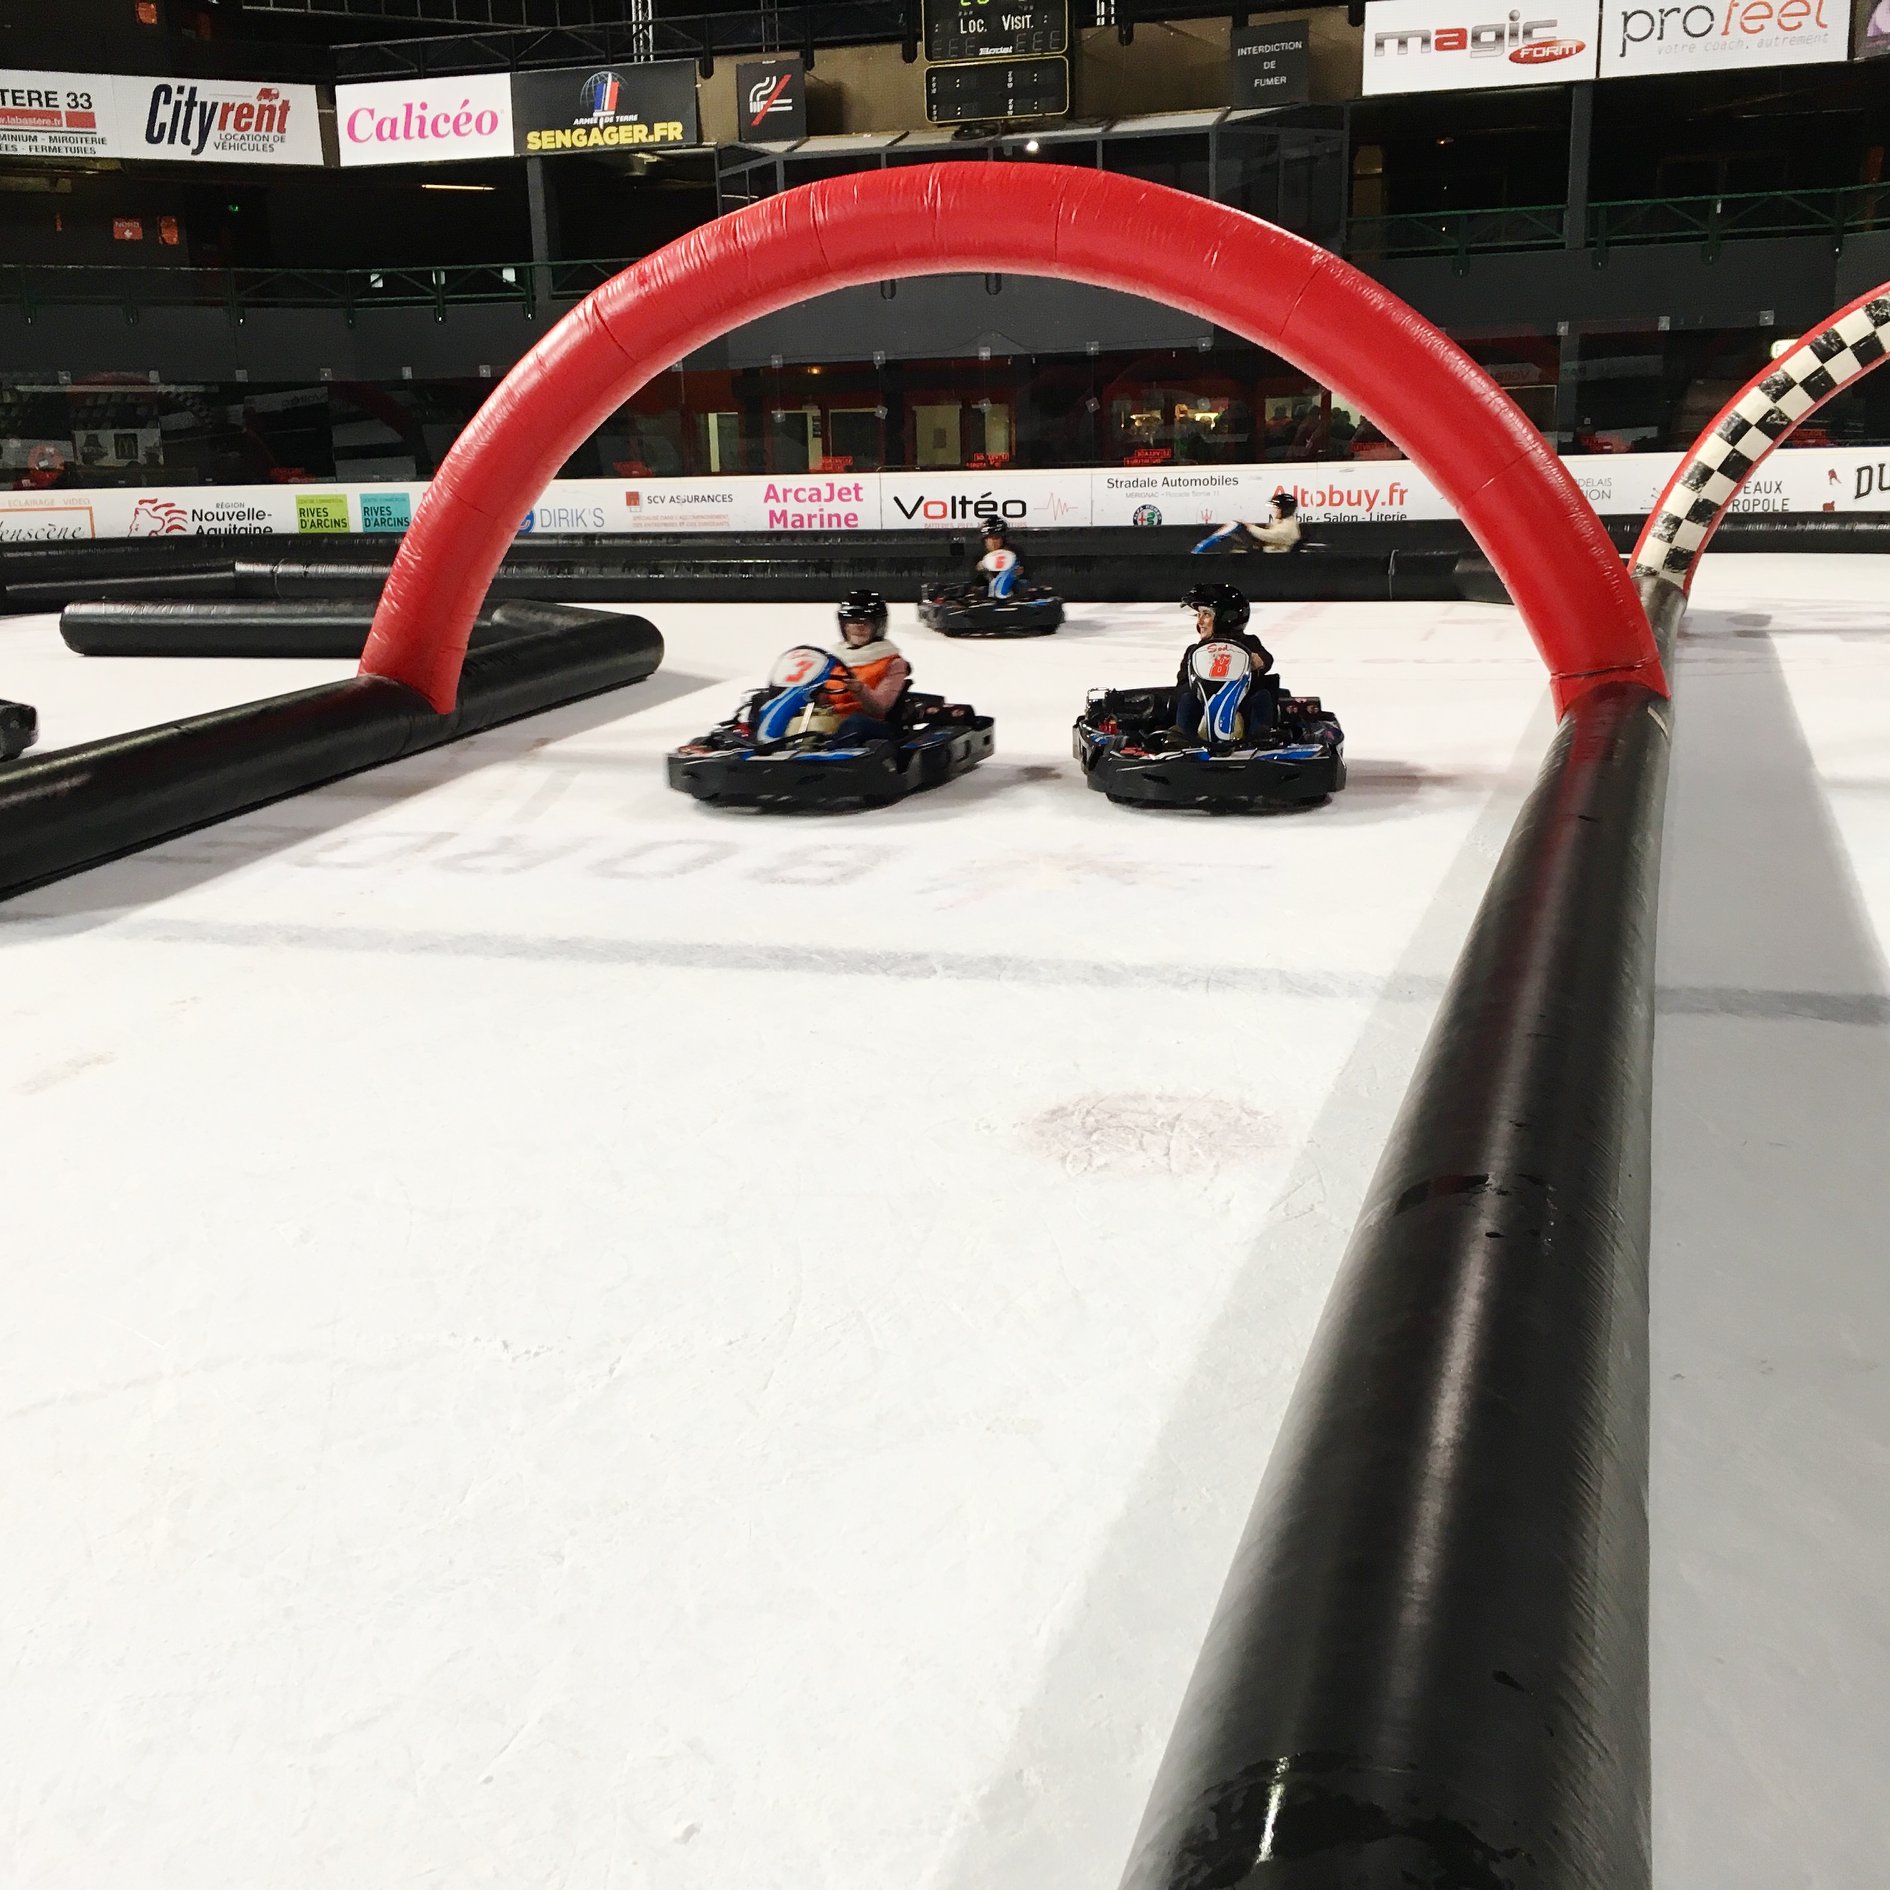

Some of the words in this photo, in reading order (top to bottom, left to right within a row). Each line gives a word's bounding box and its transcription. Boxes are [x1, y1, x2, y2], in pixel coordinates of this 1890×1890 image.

[960, 18, 988, 34] LOC.
[1001, 14, 1034, 31] VISIT.
[1374, 9, 1558, 58] magic
[1757, 32, 1829, 48] autrement
[1237, 41, 1302, 56] INTERDICTION
[1520, 45, 1577, 58] FORM
[1263, 60, 1276, 69] DE
[1254, 76, 1287, 87] FUMER
[66, 92, 92, 109] 33
[347, 98, 499, 143] Calicéo
[616, 114, 639, 122] TERRE
[49, 136, 107, 145] MIROITERIE
[220, 133, 270, 142] LOCATION
[273, 135, 286, 143] DE
[526, 121, 684, 150] SENGAGER.FR
[29, 145, 96, 154] FERMETURES
[1107, 477, 1158, 489] Stradale
[1161, 475, 1239, 487] Automobiles
[647, 495, 666, 504] SCV
[669, 493, 734, 505] ASSURANCES
[763, 483, 863, 503] ArcaJet
[299, 507, 329, 517] RIVES
[363, 506, 392, 516] RIVES
[893, 491, 1027, 520] Voltéo
[1732, 498, 1790, 512] ROPOLE
[192, 508, 272, 522] Nouvelle-
[364, 517, 410, 527] D'ARCINS
[540, 508, 605, 528] DIRIK'S
[768, 509, 858, 529] Marine
[1323, 511, 1358, 522] Salon
[300, 519, 348, 529] D'ARCINS
[1209, 653, 1232, 677] 8
